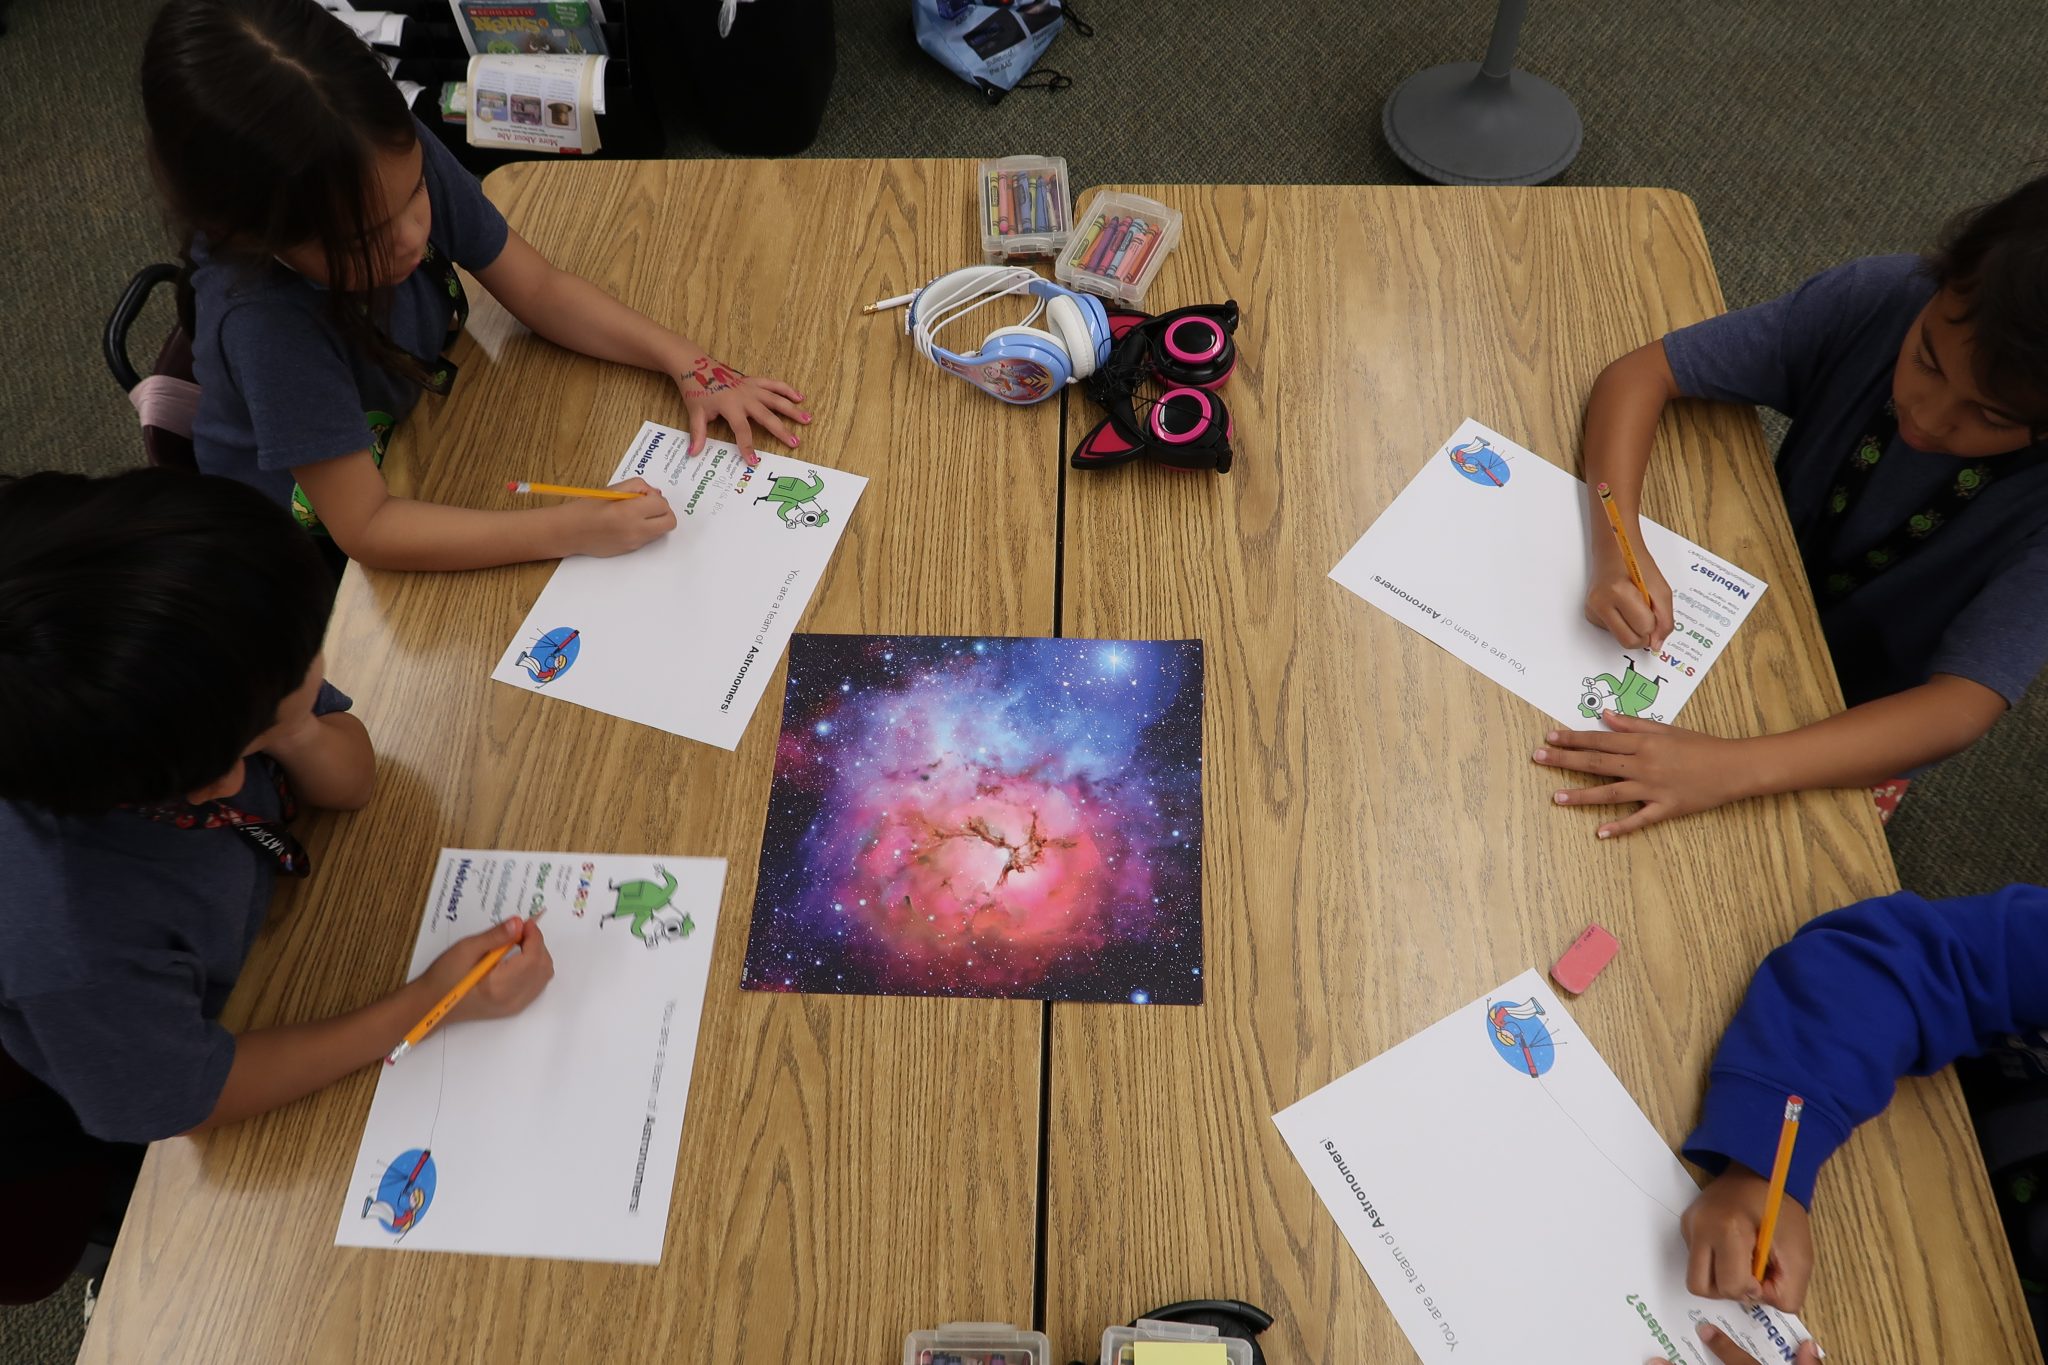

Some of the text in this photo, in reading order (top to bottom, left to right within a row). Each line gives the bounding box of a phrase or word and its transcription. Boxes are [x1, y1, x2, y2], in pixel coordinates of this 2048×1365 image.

[495, 132, 511, 140] Abe
[513, 134, 536, 143] About
[538, 137, 558, 145] More
[634, 431, 666, 475] Nebulas?
[710, 448, 728, 469] Star
[733, 454, 761, 495] ARS?
[684, 470, 716, 515] Clusters?
[784, 570, 800, 585] You
[1691, 563, 1750, 600] Nebulas?
[776, 586, 788, 601] are
[760, 611, 778, 633] team
[1370, 575, 1526, 676] You are a team of Astronomers!
[754, 634, 764, 645] of
[1686, 629, 1713, 649] Star
[721, 646, 759, 713] Astronomers!
[1320, 1139, 1459, 1352] You are a team of Astronomers!
